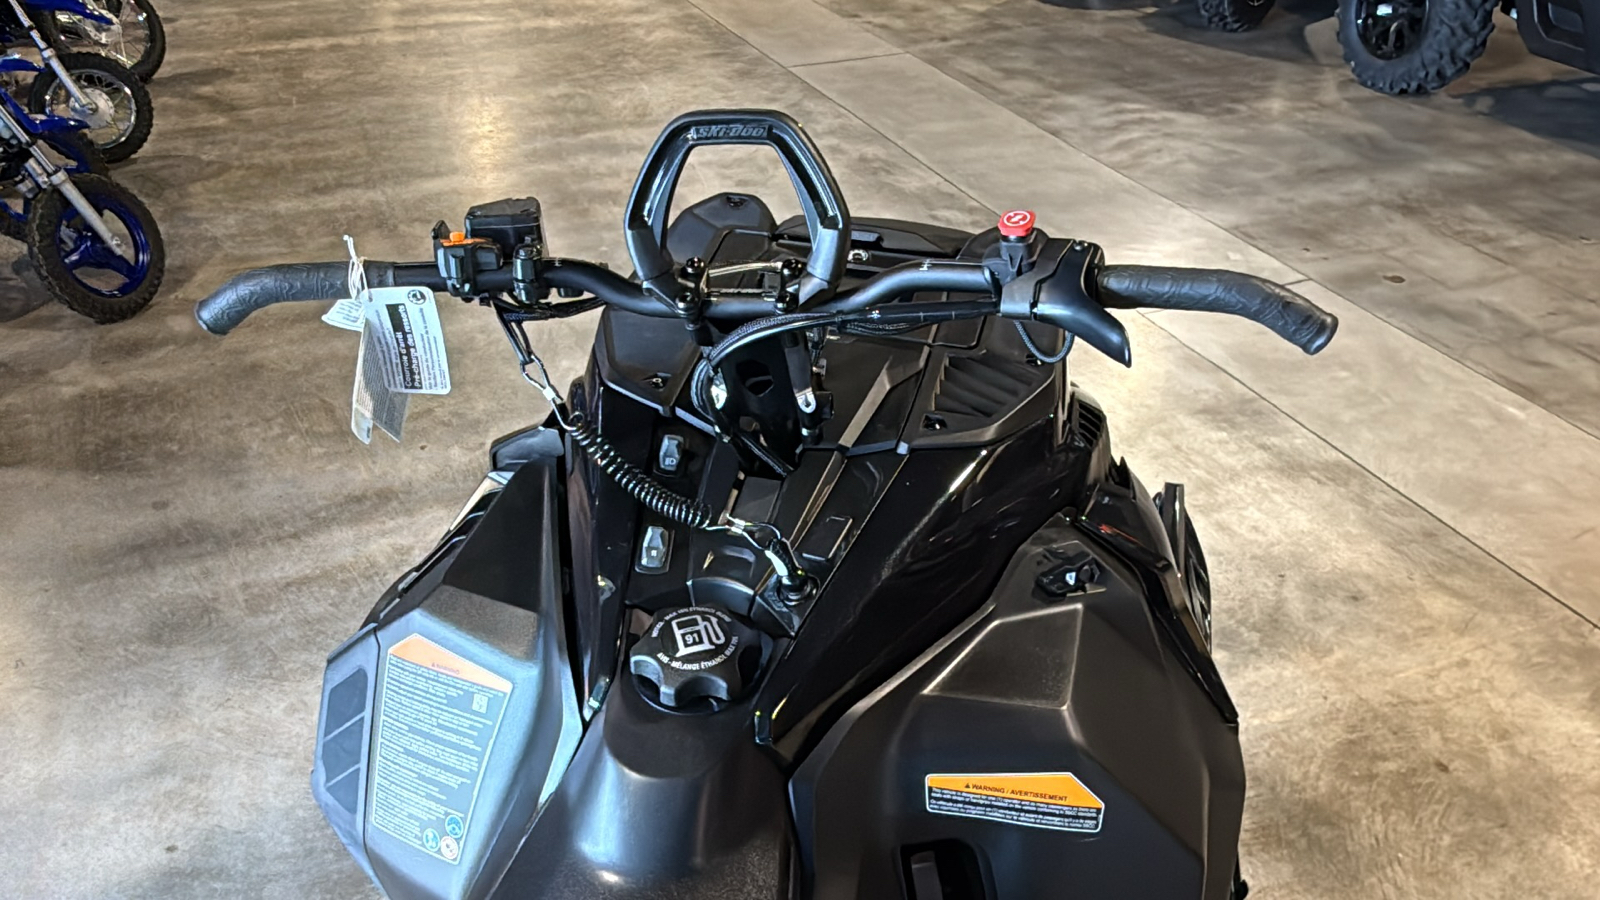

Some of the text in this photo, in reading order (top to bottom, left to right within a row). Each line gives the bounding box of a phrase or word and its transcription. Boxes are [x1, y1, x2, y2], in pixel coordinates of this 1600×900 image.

[398, 304, 411, 333] ressorts
[402, 355, 412, 387] Courroie
[410, 348, 422, 388] Pré-charge
[685, 633, 699, 644] 91
[671, 660, 700, 670] MÉLANGE
[971, 783, 1005, 794] WARNING
[1010, 789, 1068, 802] AVERTISSEMENT
